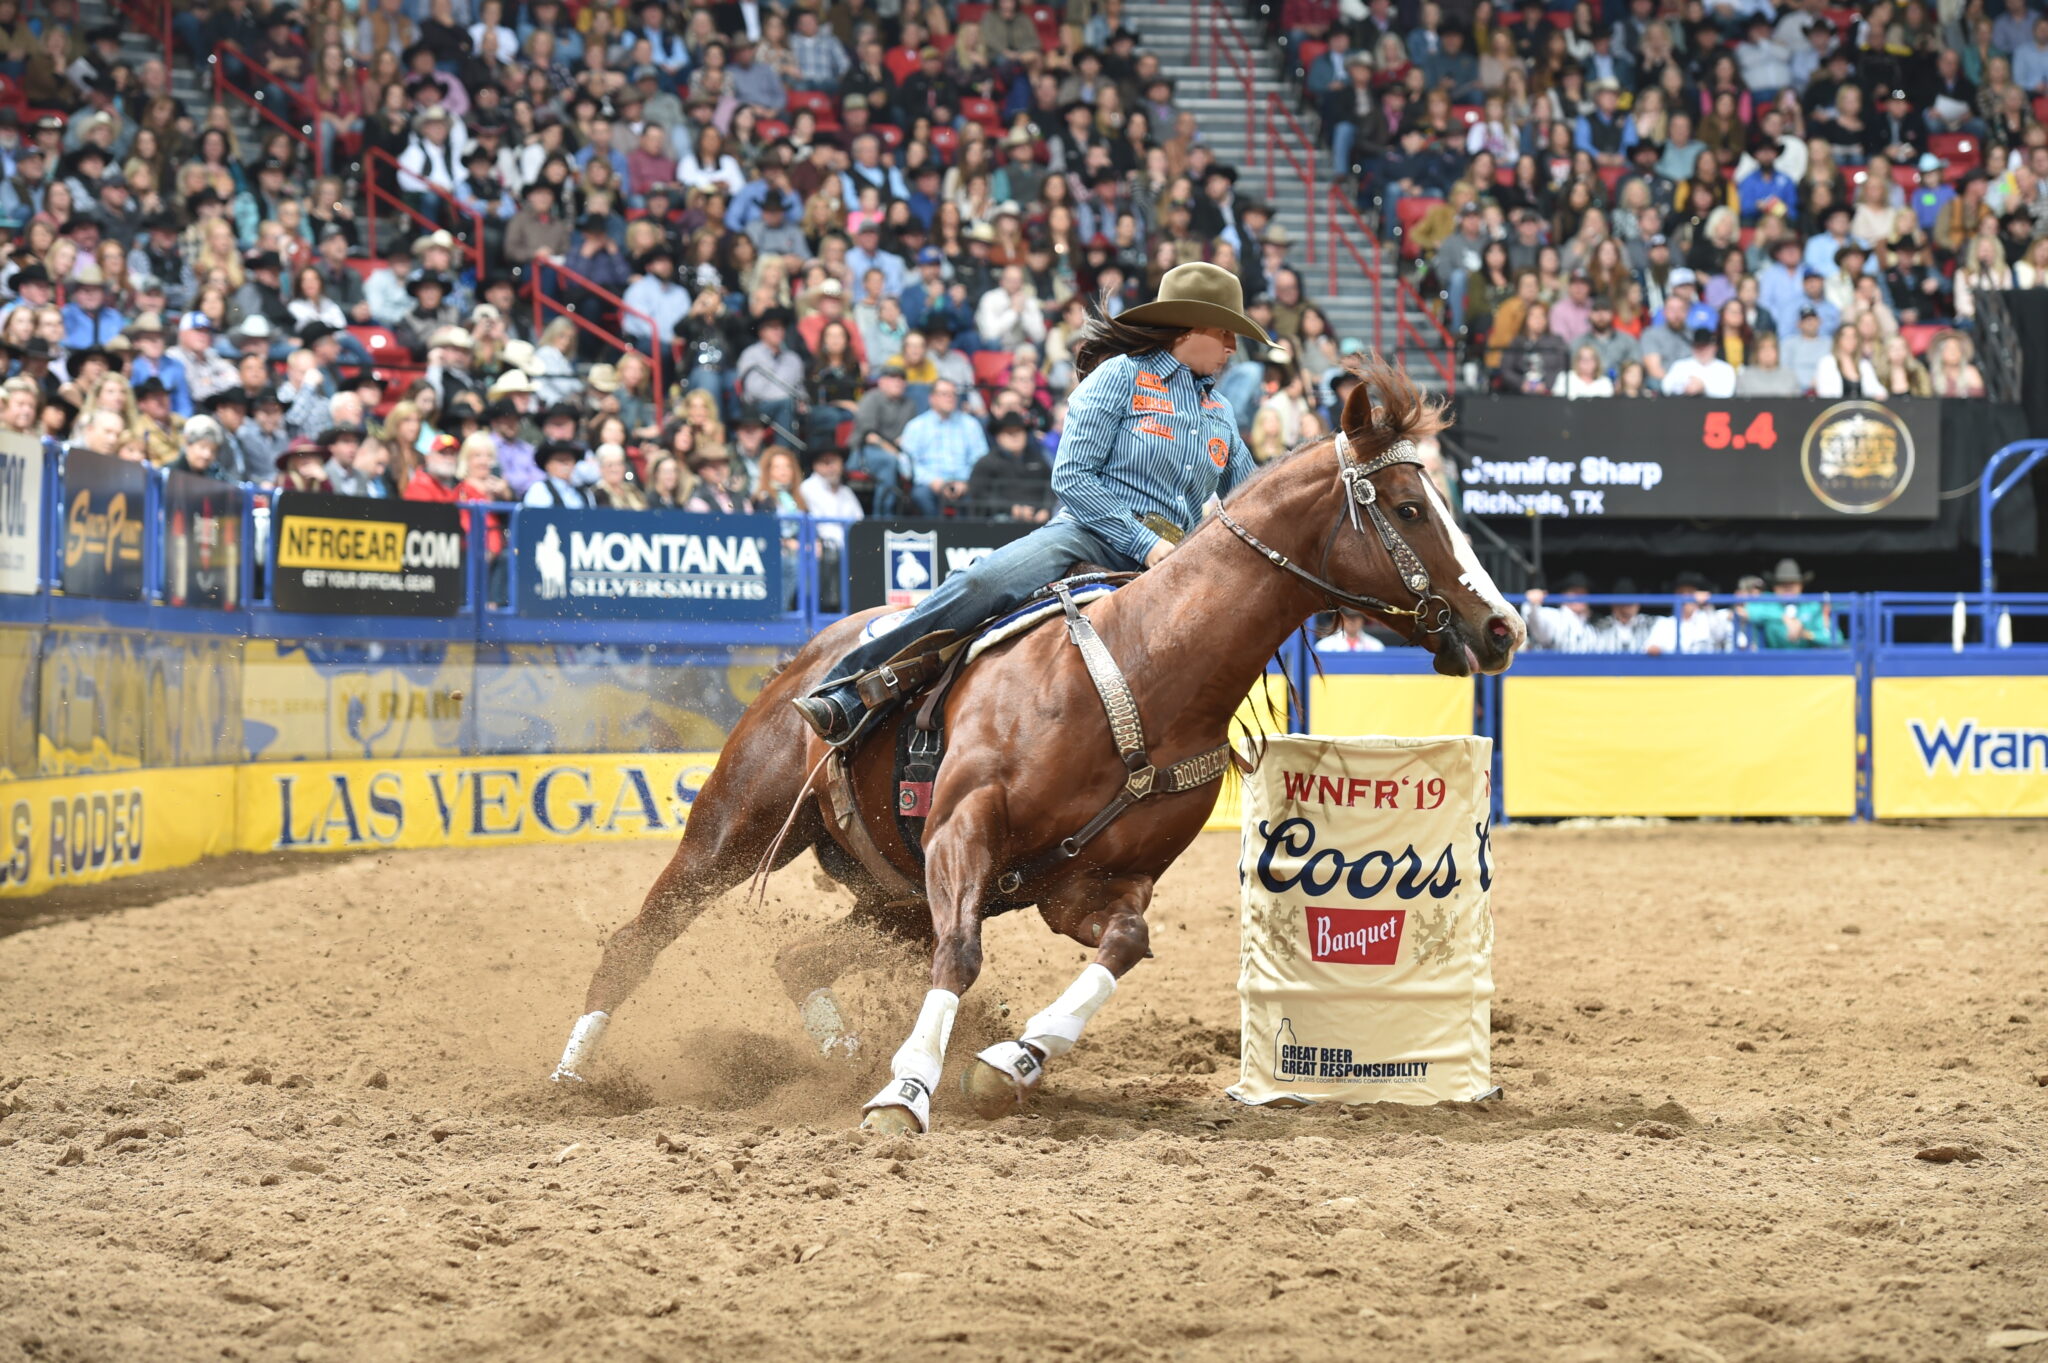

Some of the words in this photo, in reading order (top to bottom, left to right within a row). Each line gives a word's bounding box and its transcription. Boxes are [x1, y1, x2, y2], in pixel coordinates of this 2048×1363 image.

[1703, 411, 1777, 450] 5.4
[1461, 456, 1575, 485] Jennifer
[1580, 456, 1662, 491] Sharp
[1570, 490, 1604, 514] TX
[287, 526, 460, 569] NFRGEAR.COM
[569, 531, 765, 575] MONTANA
[569, 578, 768, 600] SILVERSMITHS
[1911, 724, 2048, 768] Wran
[1174, 752, 1219, 786] DOUBLE
[273, 771, 404, 849] LAS
[48, 787, 144, 880] RODEO
[1257, 817, 1462, 899] Coors
[1317, 915, 1397, 957] Banquet
[1281, 1060, 1317, 1076] GREAT
[1320, 1062, 1428, 1078] RESPONSIBILITY
[1282, 1044, 1318, 1061] GREAT
[1320, 1048, 1353, 1063] BEER
